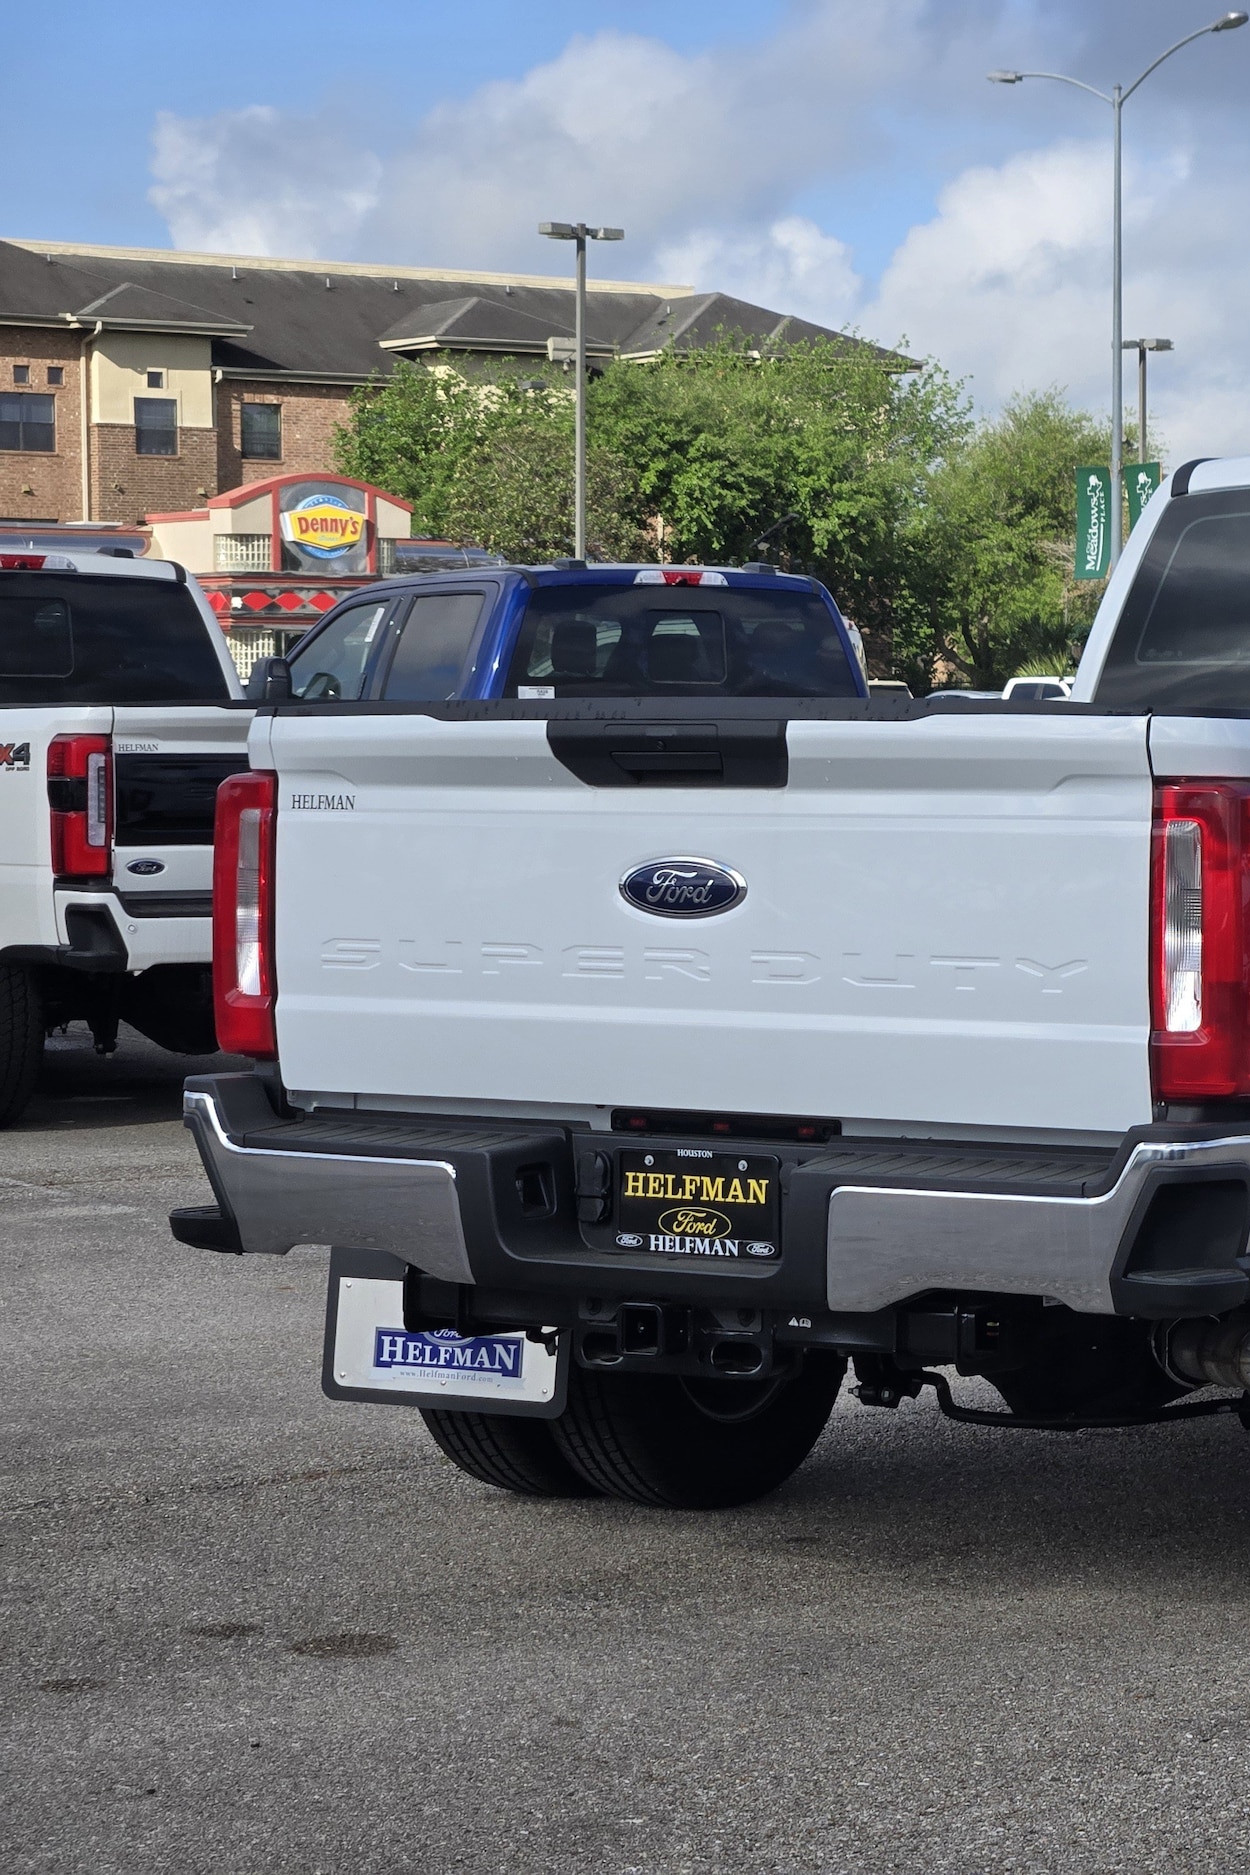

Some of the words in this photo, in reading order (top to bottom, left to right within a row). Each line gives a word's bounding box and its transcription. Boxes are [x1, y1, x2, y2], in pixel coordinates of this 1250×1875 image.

[297, 515, 360, 537] Denny's
[1085, 497, 1099, 571] Meadows
[118, 743, 159, 752] HELFMAN
[291, 793, 356, 811] HELFMAN
[646, 868, 714, 904] Ford
[320, 937, 711, 983] SUPER
[750, 949, 1089, 994] DUTY
[676, 1148, 713, 1159] HOUSTON
[624, 1171, 770, 1205] HELFMAN
[672, 1209, 718, 1236] Ford
[620, 1235, 638, 1245] Ford
[649, 1234, 740, 1257] HELFMAN
[751, 1243, 770, 1254] Ford
[379, 1335, 518, 1371] HELFMAN
[400, 1369, 494, 1383] www.HelfmanFord.com
